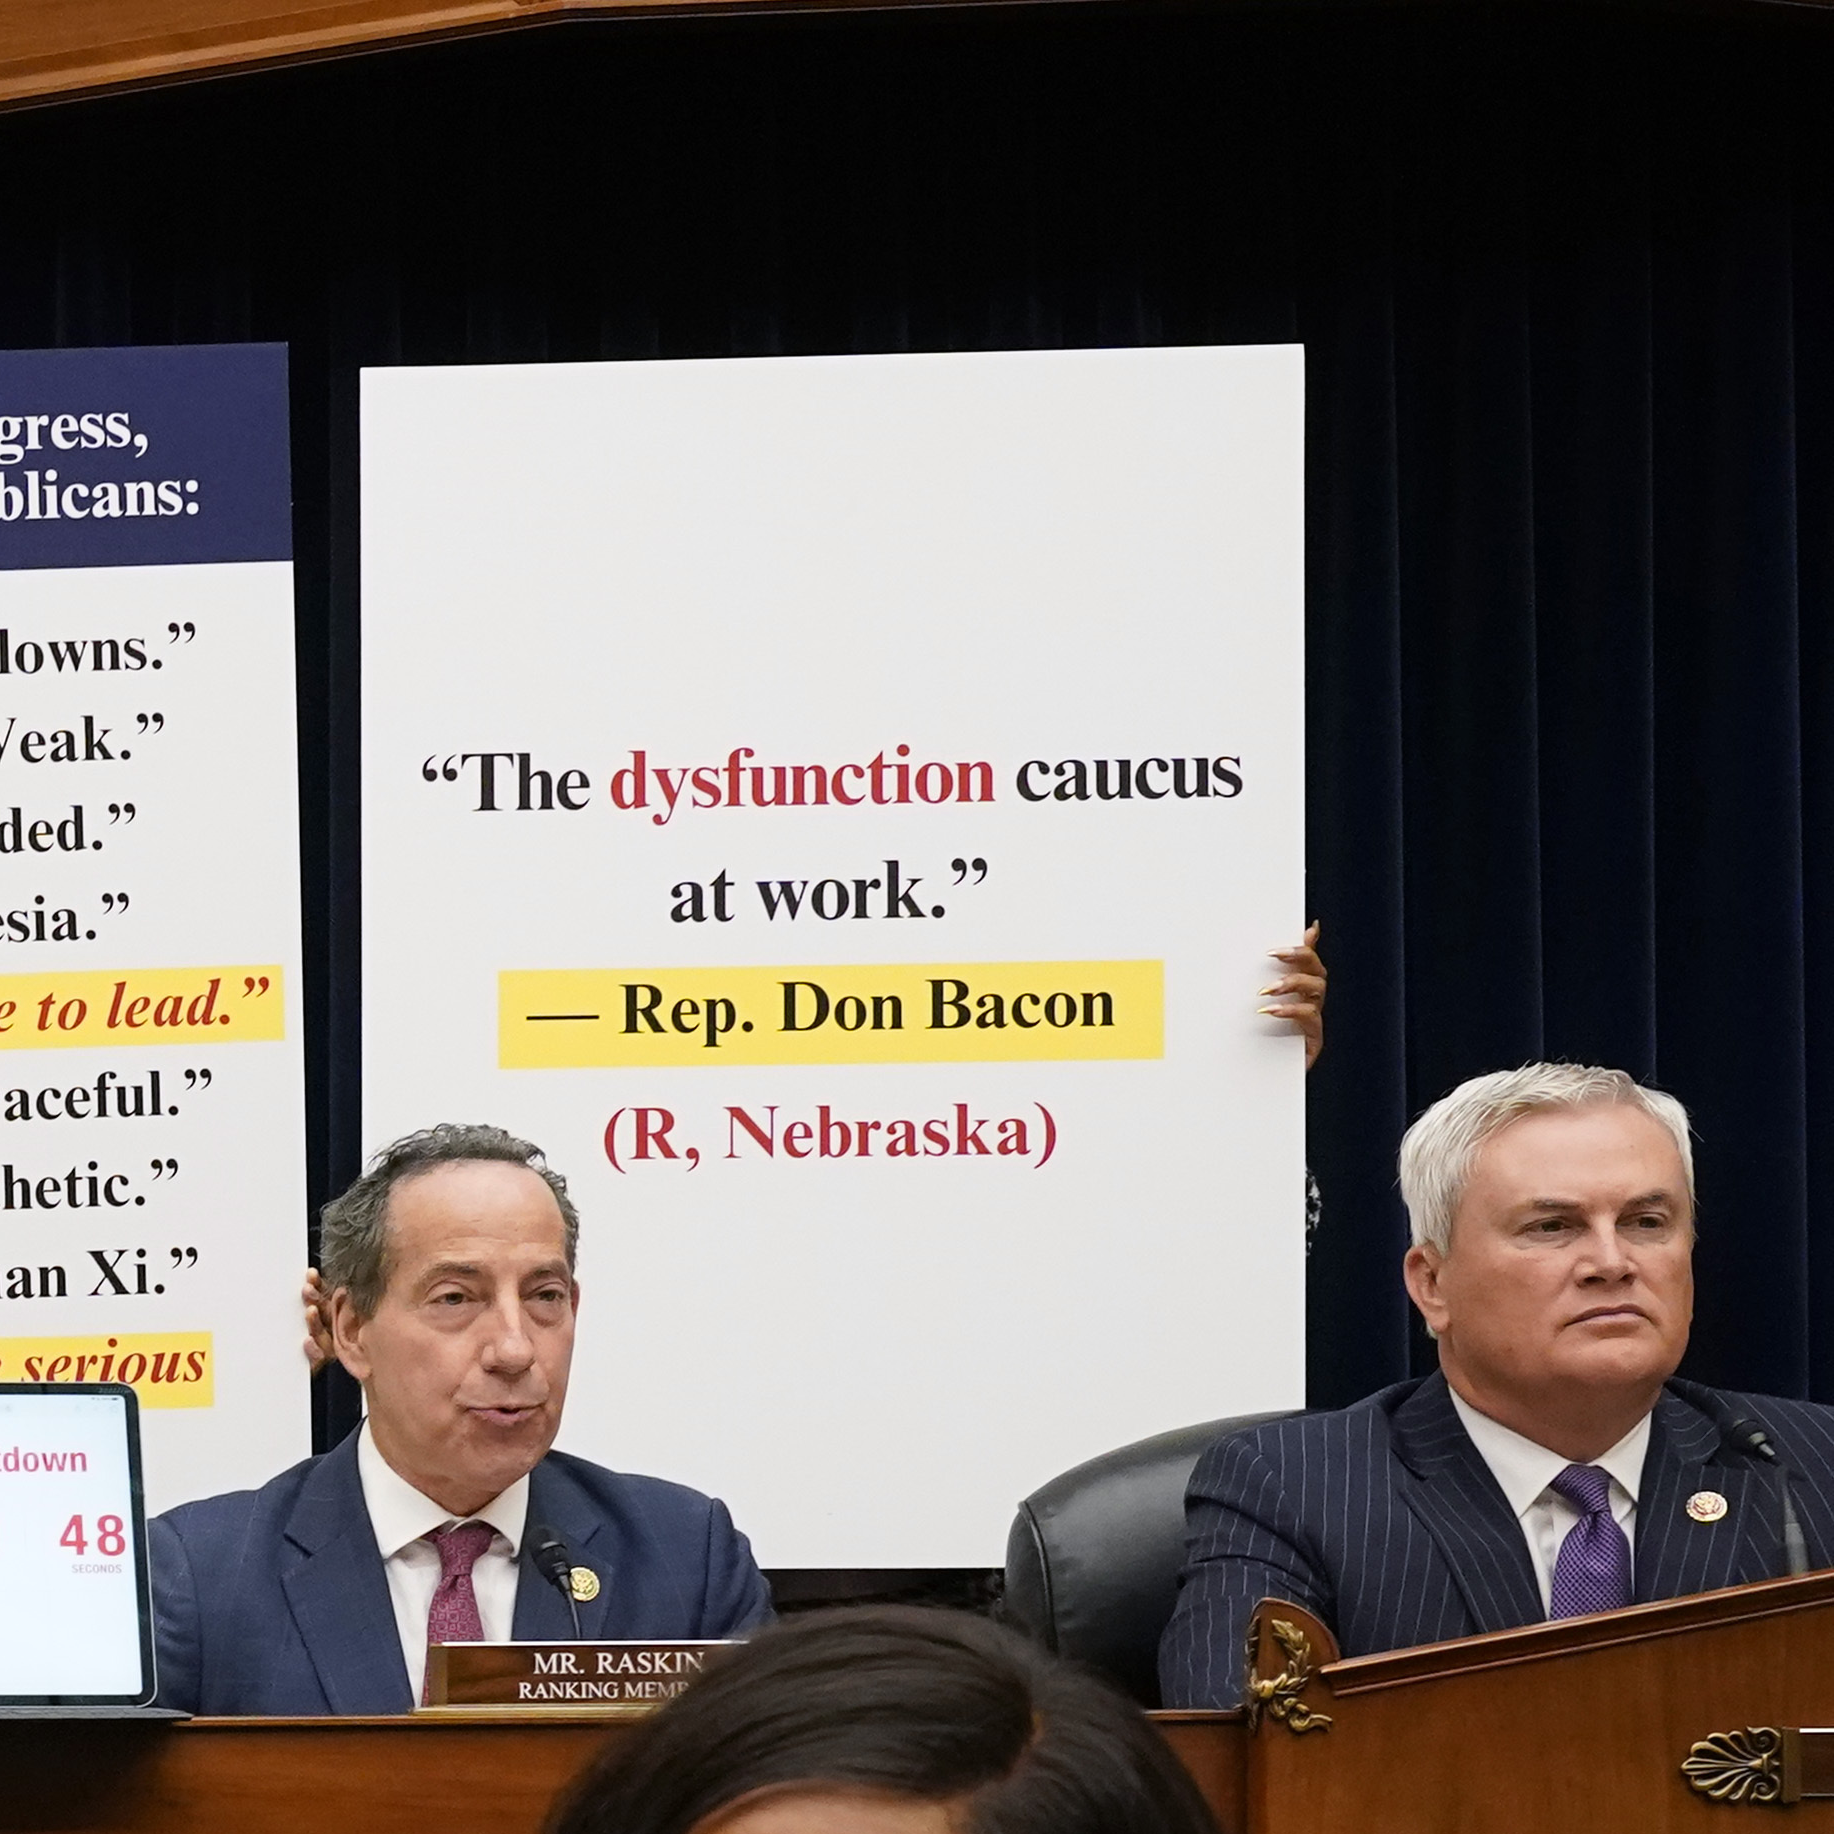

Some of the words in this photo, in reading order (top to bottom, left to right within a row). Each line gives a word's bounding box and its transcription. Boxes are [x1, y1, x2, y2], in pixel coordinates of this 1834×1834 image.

[423, 753, 590, 811] “The
[611, 744, 995, 825] dysfunction
[1017, 757, 1242, 801] caucus
[671, 869, 734, 922] at
[756, 858, 987, 920] work.”
[38, 993, 86, 1030] to
[107, 977, 269, 1028] lead.”
[621, 985, 753, 1047] Rep.
[780, 982, 903, 1031] Don
[927, 980, 1114, 1029] Bacon
[605, 1108, 699, 1173] (R,
[726, 1103, 1056, 1168] Nebraska)
[88, 1247, 197, 1296] Xi.”
[22, 1338, 207, 1384] serious
[60, 1515, 126, 1555] 48
[71, 1564, 122, 1574] SECONDS
[533, 1653, 585, 1674] MR.
[597, 1652, 704, 1674] RASKIN
[519, 1683, 619, 1699] RANKING
